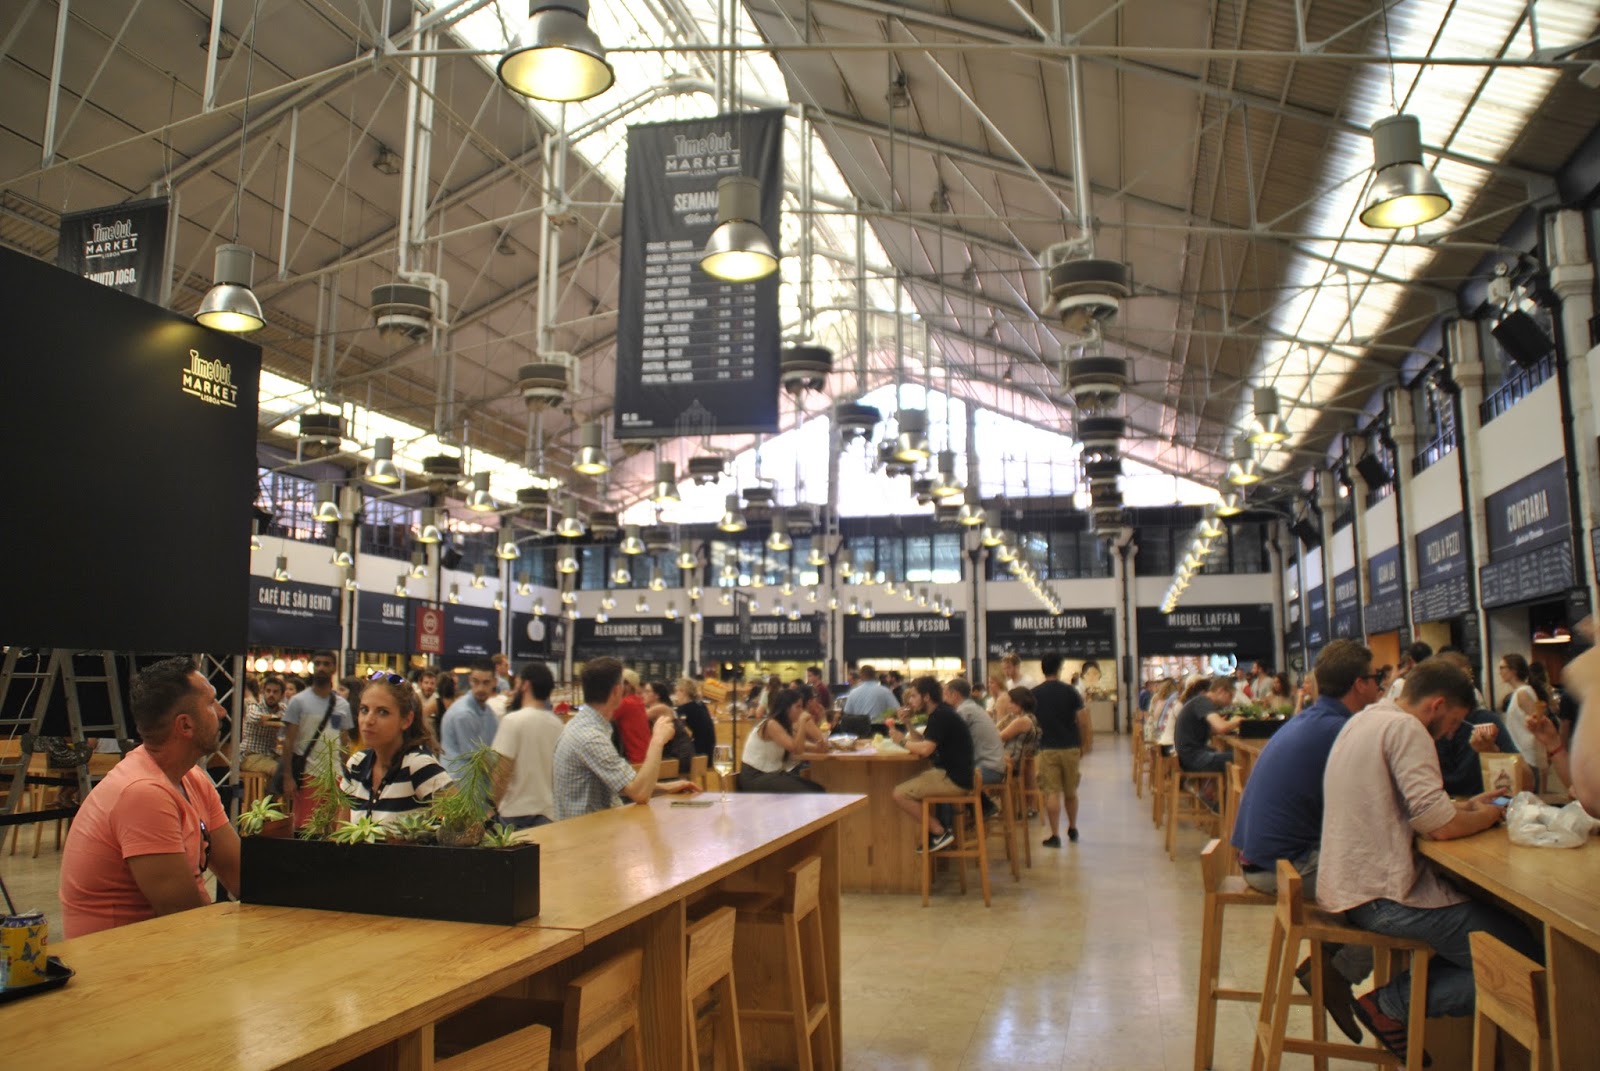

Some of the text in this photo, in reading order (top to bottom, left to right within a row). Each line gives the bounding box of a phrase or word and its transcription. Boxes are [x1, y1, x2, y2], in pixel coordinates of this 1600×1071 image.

[665, 154, 740, 171] MARKET
[86, 238, 138, 255] MARKET
[101, 251, 121, 259] LISBOA
[183, 374, 237, 402] MARKET
[200, 394, 221, 405] LISBOA
[1507, 489, 1549, 533] CONFRARIA
[258, 586, 332, 612] CAFÉ DE SÃO BENTO
[859, 617, 951, 633] HENRIQUE SÁ PESSOA
[1014, 615, 1088, 629] MARLENE VIEIRA
[1168, 612, 1241, 626] MIGUEL LAFFAN
[594, 624, 663, 636] ALEXANDRE SILVA
[751, 622, 779, 635] ASTRO
[780, 622, 786, 634] E
[787, 621, 812, 634] SILVA
